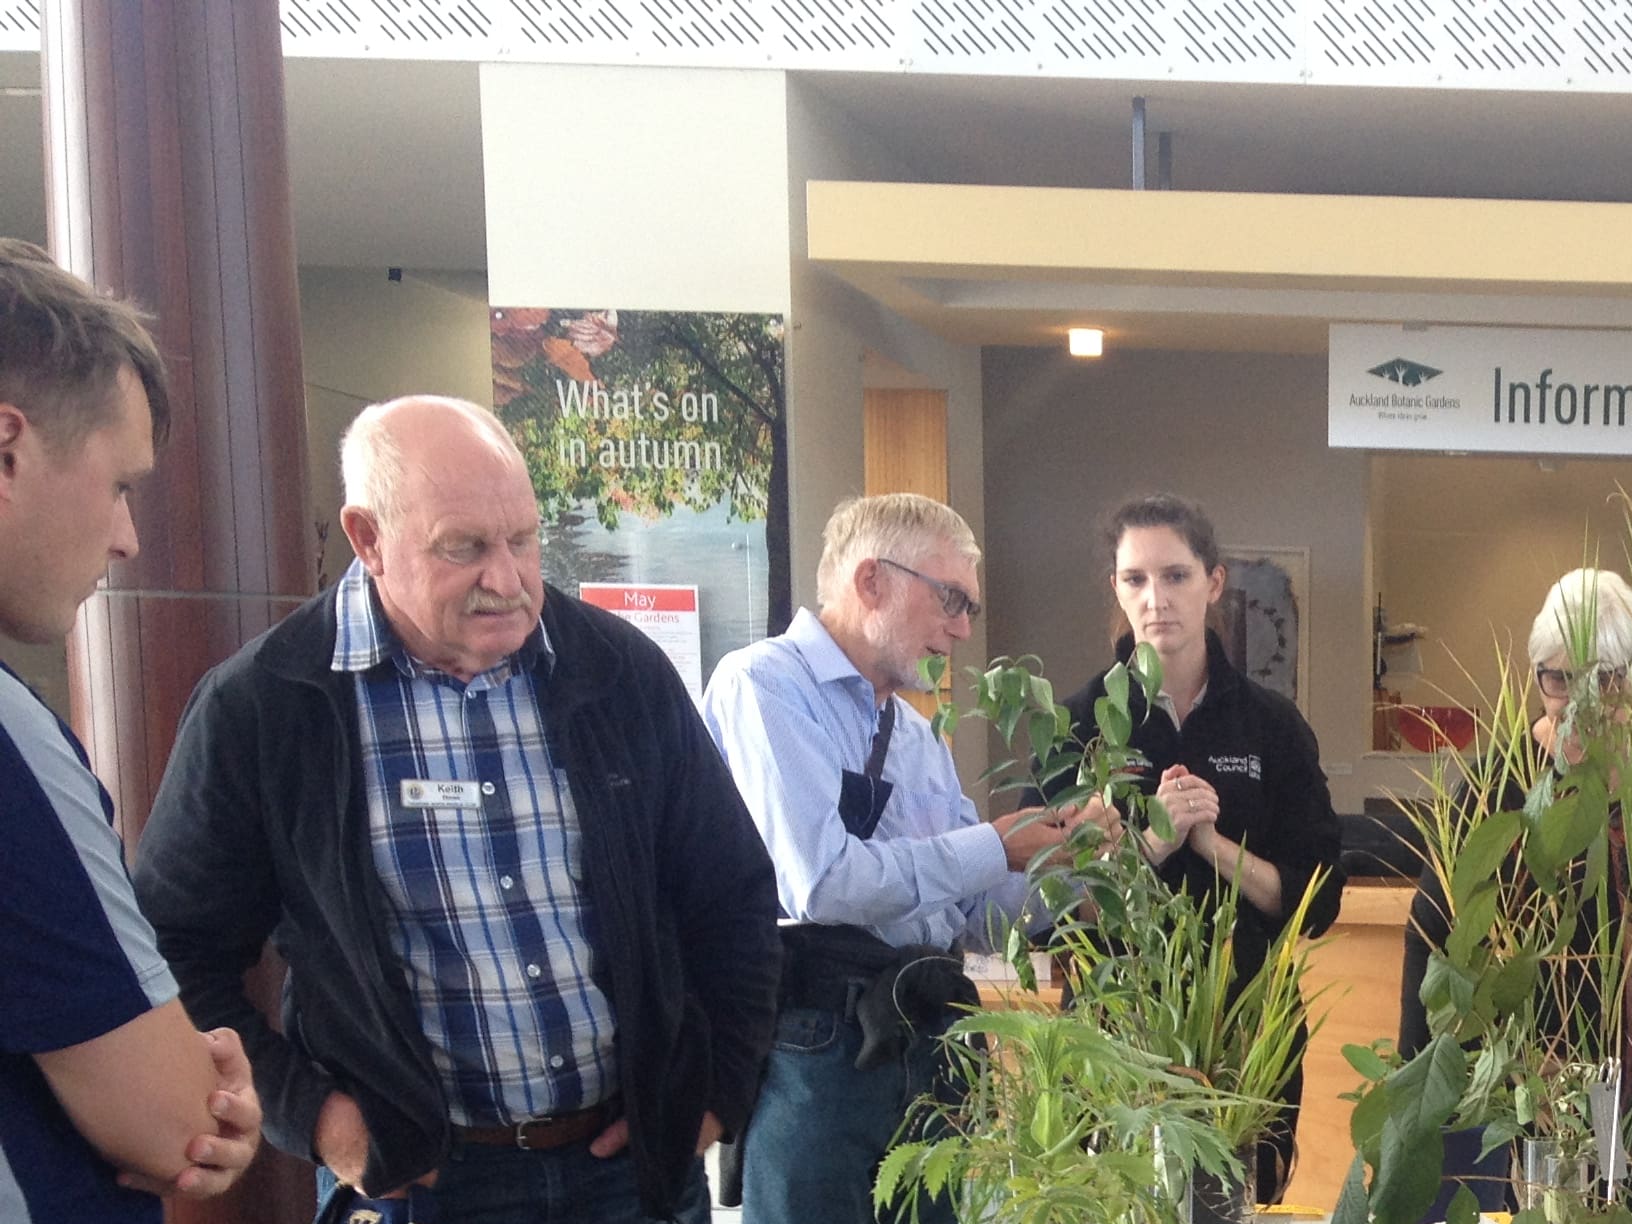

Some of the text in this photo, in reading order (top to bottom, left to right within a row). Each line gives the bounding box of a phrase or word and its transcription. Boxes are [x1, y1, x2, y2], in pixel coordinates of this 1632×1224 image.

[555, 379, 719, 423] What's on
[1349, 393, 1461, 409] Auckland Botanic Gardens
[559, 429, 722, 470] in autumn
[623, 591, 656, 611] May
[634, 612, 680, 624] Gardens
[1207, 755, 1248, 765] Auckland
[1215, 763, 1248, 773] Council
[437, 783, 464, 793] Keith
